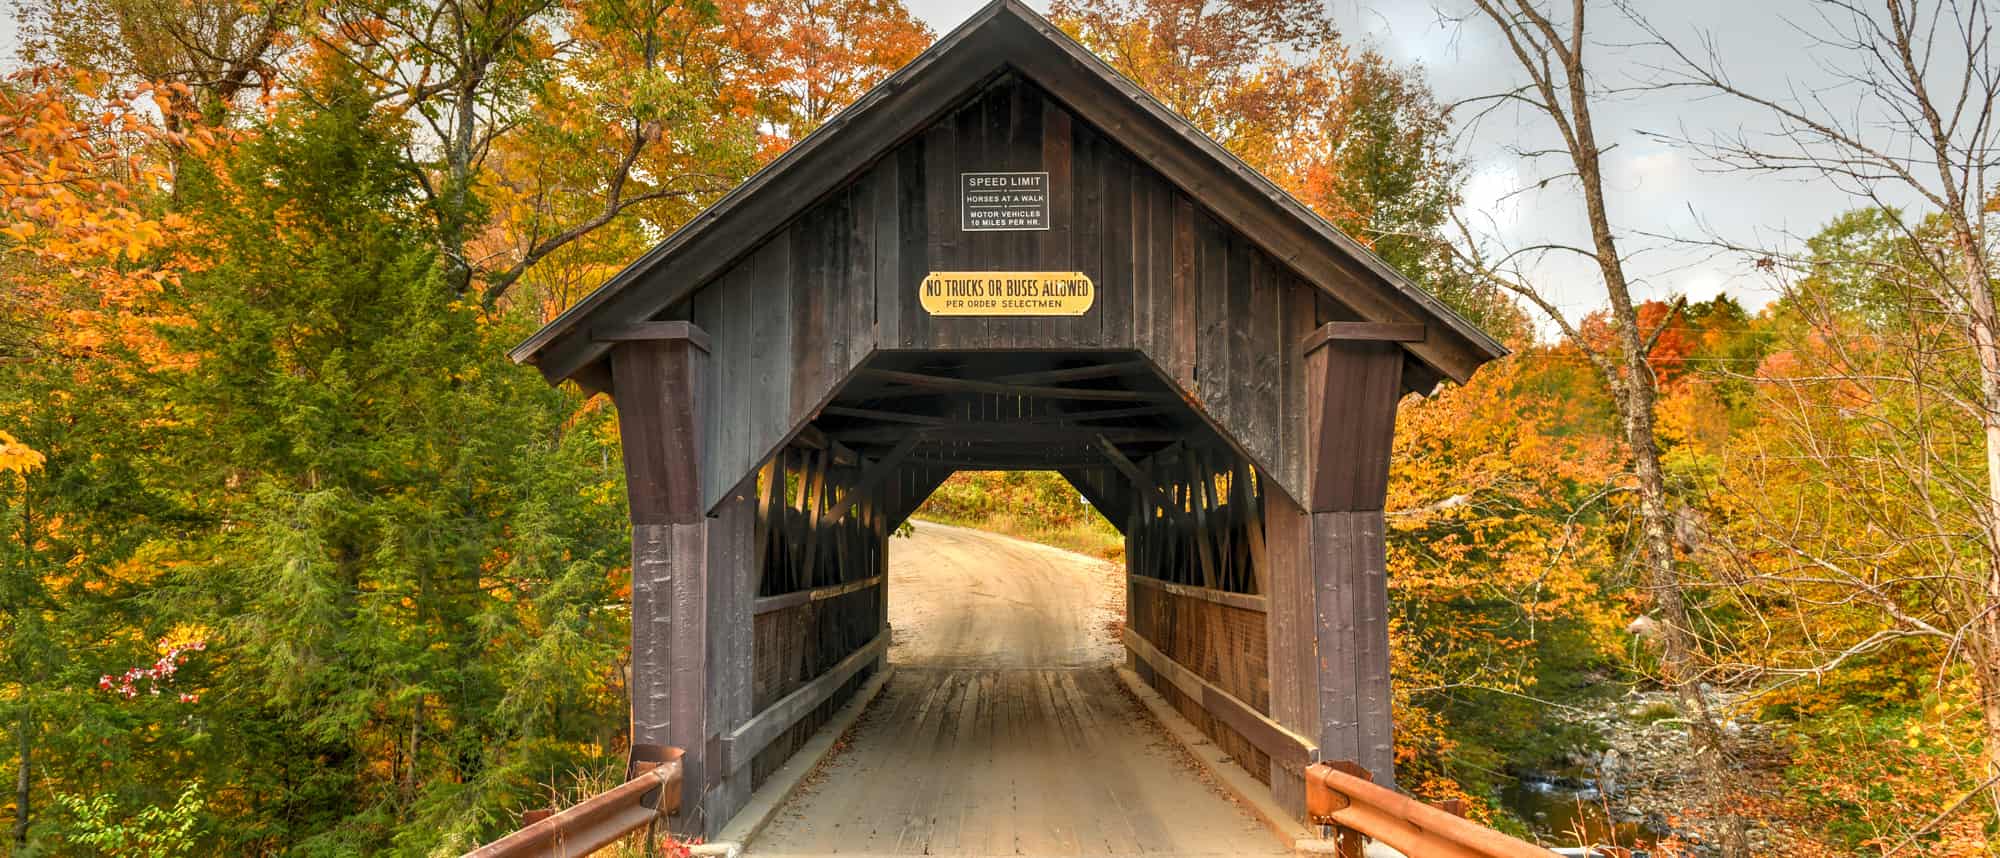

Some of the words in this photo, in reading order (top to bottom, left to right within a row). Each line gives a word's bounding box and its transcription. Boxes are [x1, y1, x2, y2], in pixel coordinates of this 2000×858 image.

[969, 177, 1007, 186] SPEED
[1011, 176, 1040, 186] LIMIT
[966, 195, 1000, 203] HORSES
[926, 279, 942, 297] NO
[944, 279, 984, 297] TRUCKS
[988, 279, 1002, 297] OR
[1006, 279, 1038, 297] BUSES
[1042, 279, 1089, 297] ALLOWED
[946, 300, 964, 308] PER
[967, 300, 997, 308] ORDER
[1002, 299, 1062, 308] SELECTMEN
